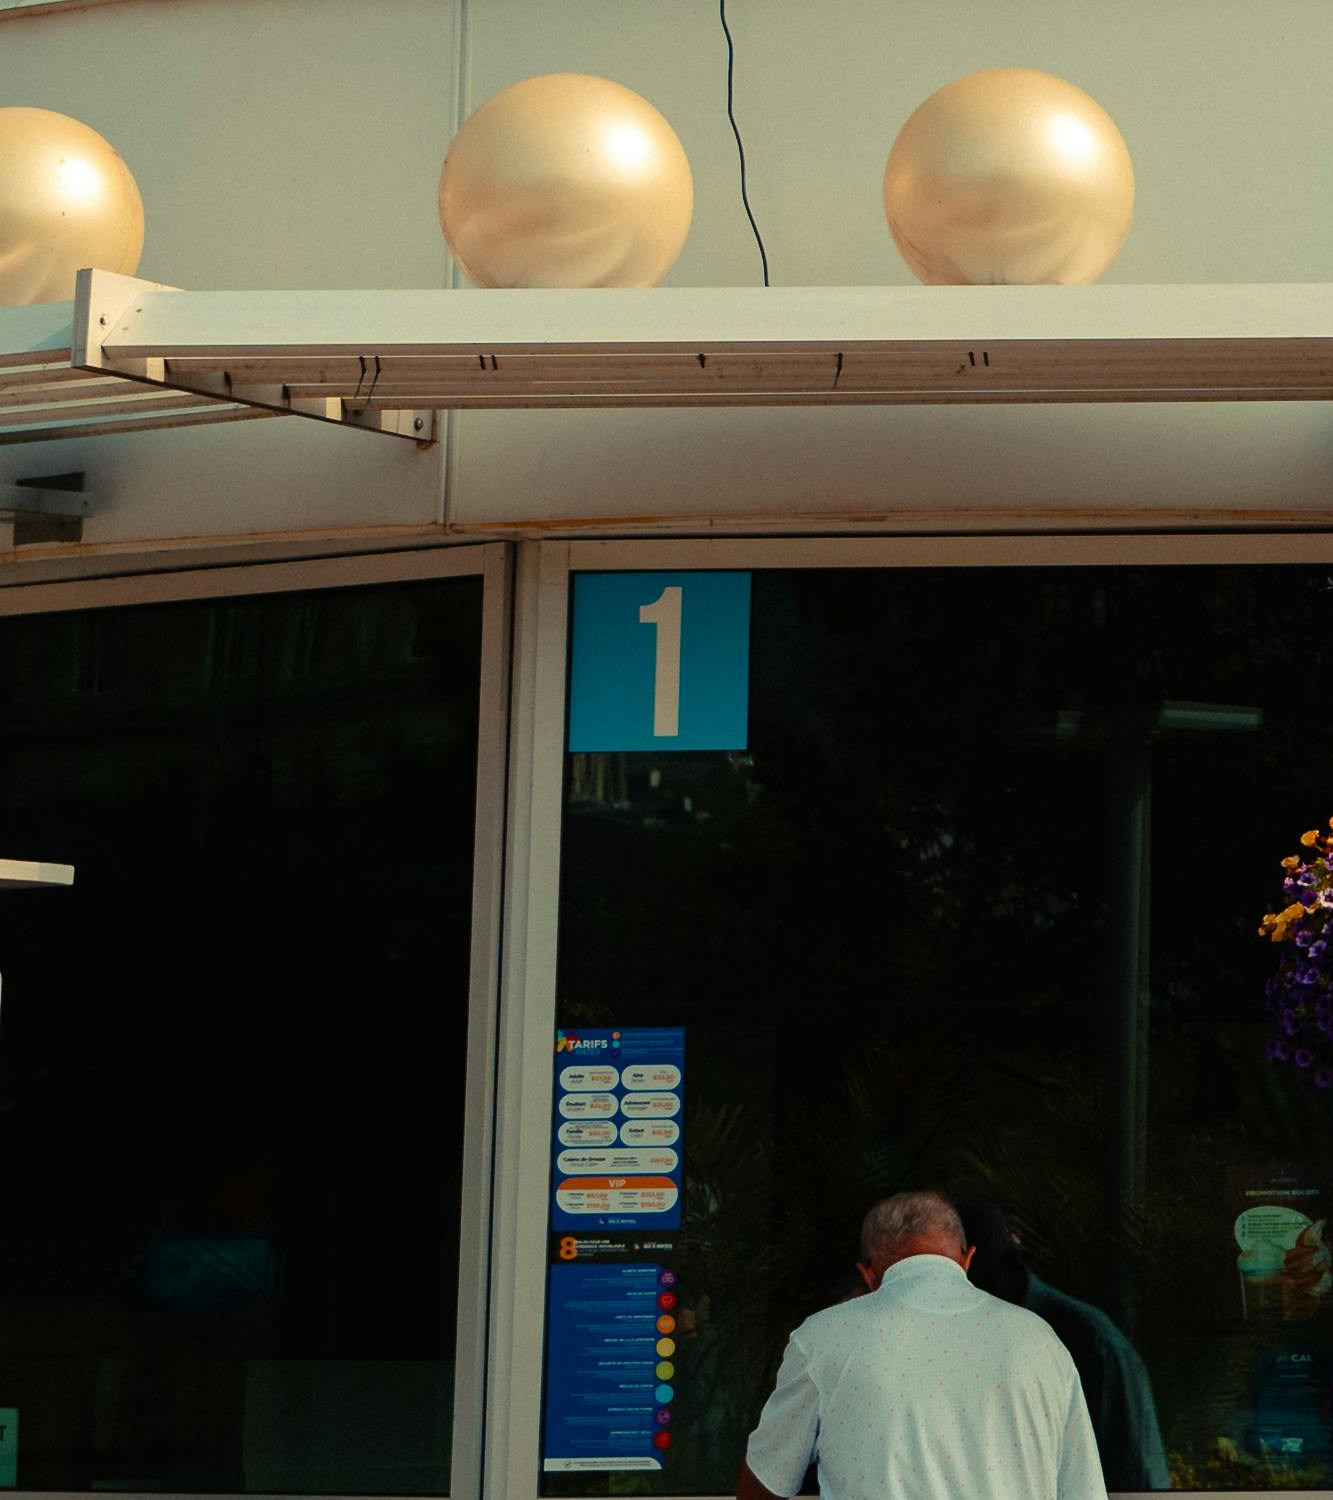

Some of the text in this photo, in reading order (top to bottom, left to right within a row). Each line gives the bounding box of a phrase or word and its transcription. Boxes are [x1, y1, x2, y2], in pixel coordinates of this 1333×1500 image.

[639, 586, 682, 737] 1
[568, 1039, 608, 1049] TARIFS
[609, 1179, 626, 1188] VIP
[560, 1236, 577, 1260] 8
